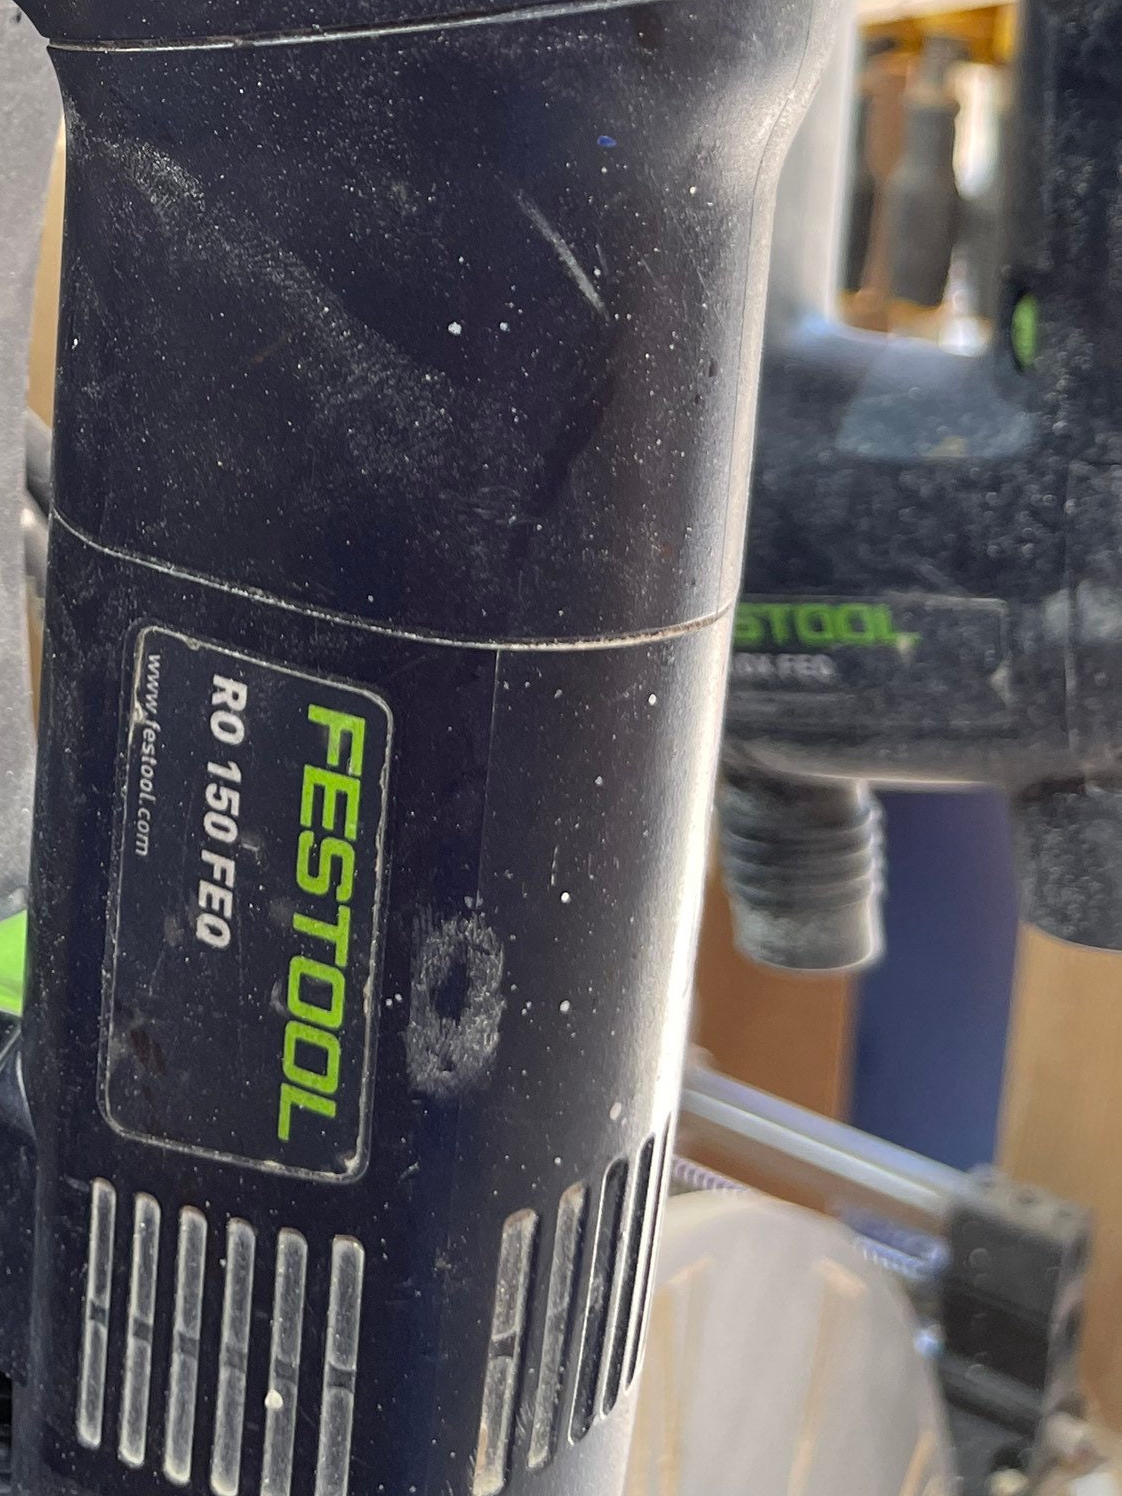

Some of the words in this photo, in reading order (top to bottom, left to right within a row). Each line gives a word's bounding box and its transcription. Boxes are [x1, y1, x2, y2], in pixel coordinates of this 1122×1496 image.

[733, 603, 923, 646] STOOL
[135, 654, 161, 856] www.festool.com
[209, 673, 248, 746] RO
[202, 759, 242, 844] 150
[195, 849, 236, 949] FEQ
[278, 703, 366, 1141] FESTOOL
